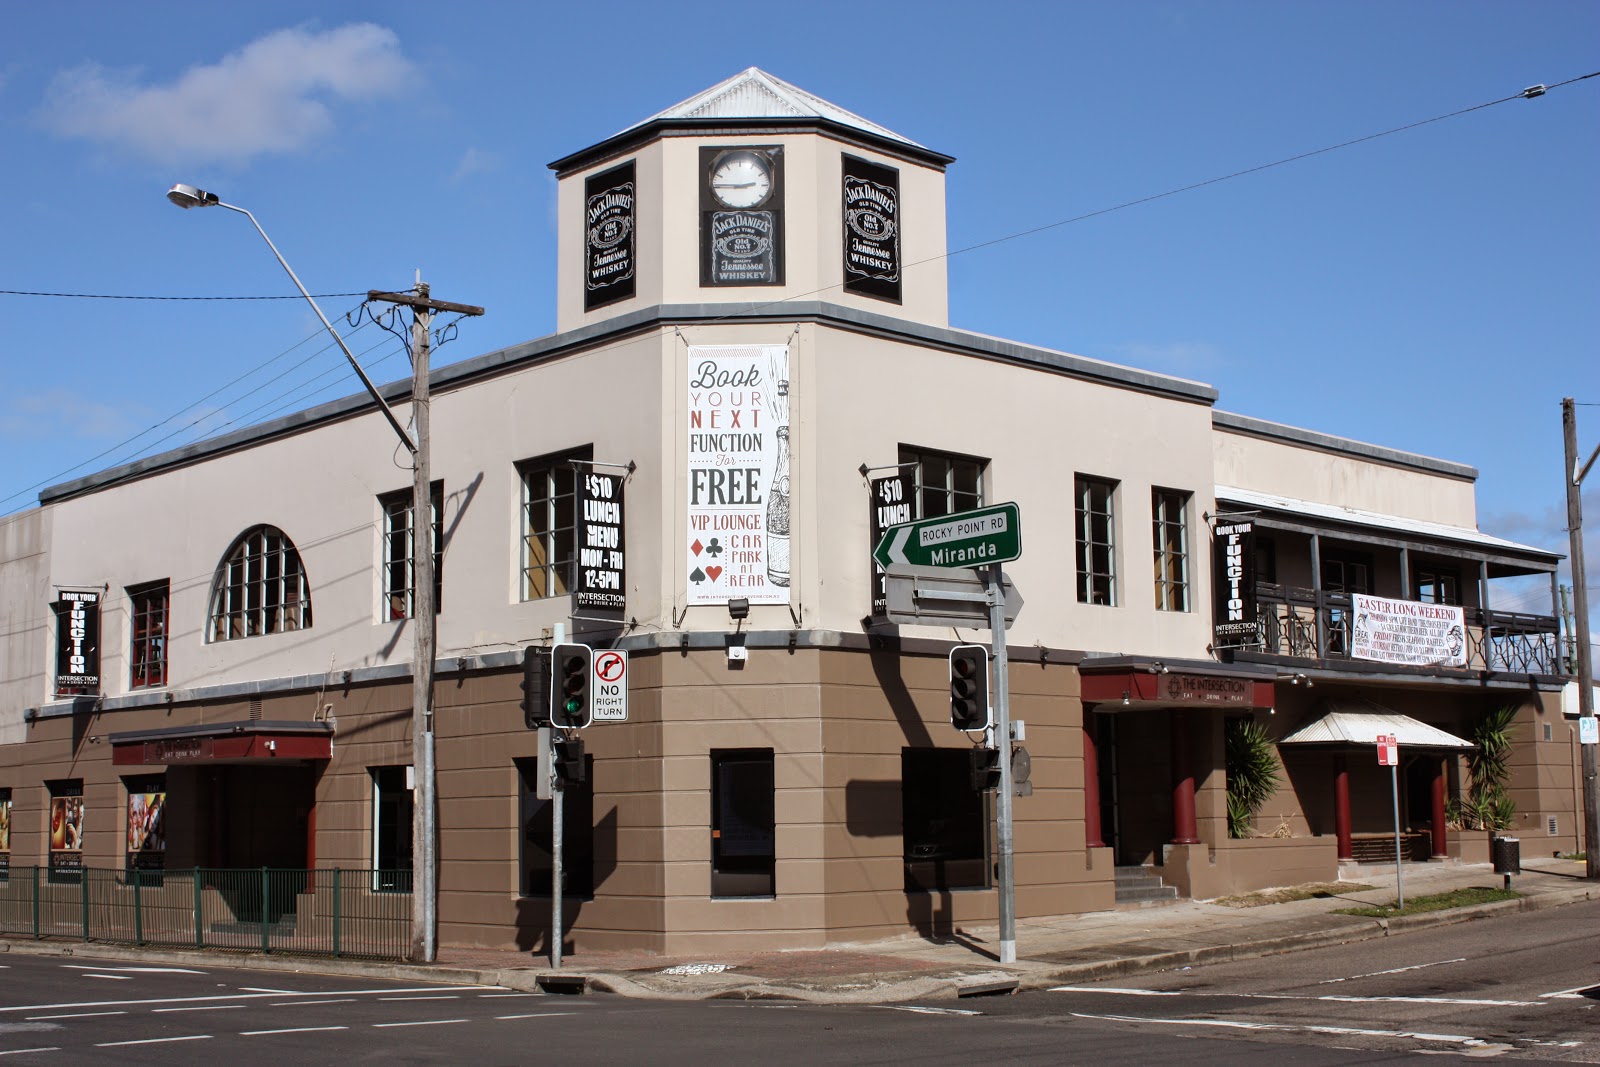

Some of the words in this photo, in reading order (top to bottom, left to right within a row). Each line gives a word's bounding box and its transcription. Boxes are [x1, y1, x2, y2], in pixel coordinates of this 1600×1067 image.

[846, 186, 865, 204] JACK
[590, 200, 606, 223] JACK
[864, 214, 877, 223] Old
[605, 222, 616, 230] Old
[715, 217, 736, 234] JACK
[852, 238, 890, 259] Tennessee
[594, 249, 628, 266] Tennessee
[721, 260, 764, 270] Tennessee
[851, 252, 892, 270] WHISKEY
[592, 259, 629, 278] WHISKEY
[719, 272, 766, 280] WHISKEY
[690, 360, 762, 389] Book
[690, 392, 762, 406] YOUR
[691, 410, 761, 428] NEXT
[690, 433, 762, 452] FUNCTION
[716, 454, 736, 466] For
[590, 474, 612, 498] $10
[690, 468, 762, 505] FREE
[884, 479, 902, 504] $10
[584, 500, 620, 524] LUNCH
[878, 503, 910, 528] LUNCH
[690, 515, 710, 530] VIP
[714, 514, 761, 530] LOUNGE
[923, 527, 952, 541] ROCKY
[958, 520, 985, 535] POINT
[992, 518, 1003, 529] RD
[1216, 525, 1234, 536] BOOK
[1234, 524, 1251, 534] YOUR
[587, 524, 618, 548] MENU
[731, 534, 762, 548] CAR
[581, 549, 602, 567] MON
[610, 550, 623, 569] FRI
[732, 550, 762, 562] PARK
[932, 542, 996, 566] Miranda
[740, 564, 752, 573] AT
[1226, 534, 1242, 620] FUNCTION
[584, 570, 620, 589] 12-5PM
[730, 574, 764, 586] REAR
[80, 593, 96, 601] YOUR
[578, 592, 624, 602] INTERSECTION
[1358, 598, 1391, 614] EASTER
[1394, 602, 1416, 616] LONG
[1418, 605, 1456, 620] WEEKEND
[1216, 622, 1256, 631] INTERSECTION
[70, 601, 85, 674] FUNCTION
[1374, 632, 1392, 641] FRIDAY
[1392, 634, 1405, 642] FRESH
[1406, 635, 1425, 645] SEAFOOD
[1355, 648, 1370, 657] SUNDAY
[601, 685, 619, 695] NO
[1182, 678, 1196, 689] THE
[1197, 680, 1245, 692] INTERSECTION
